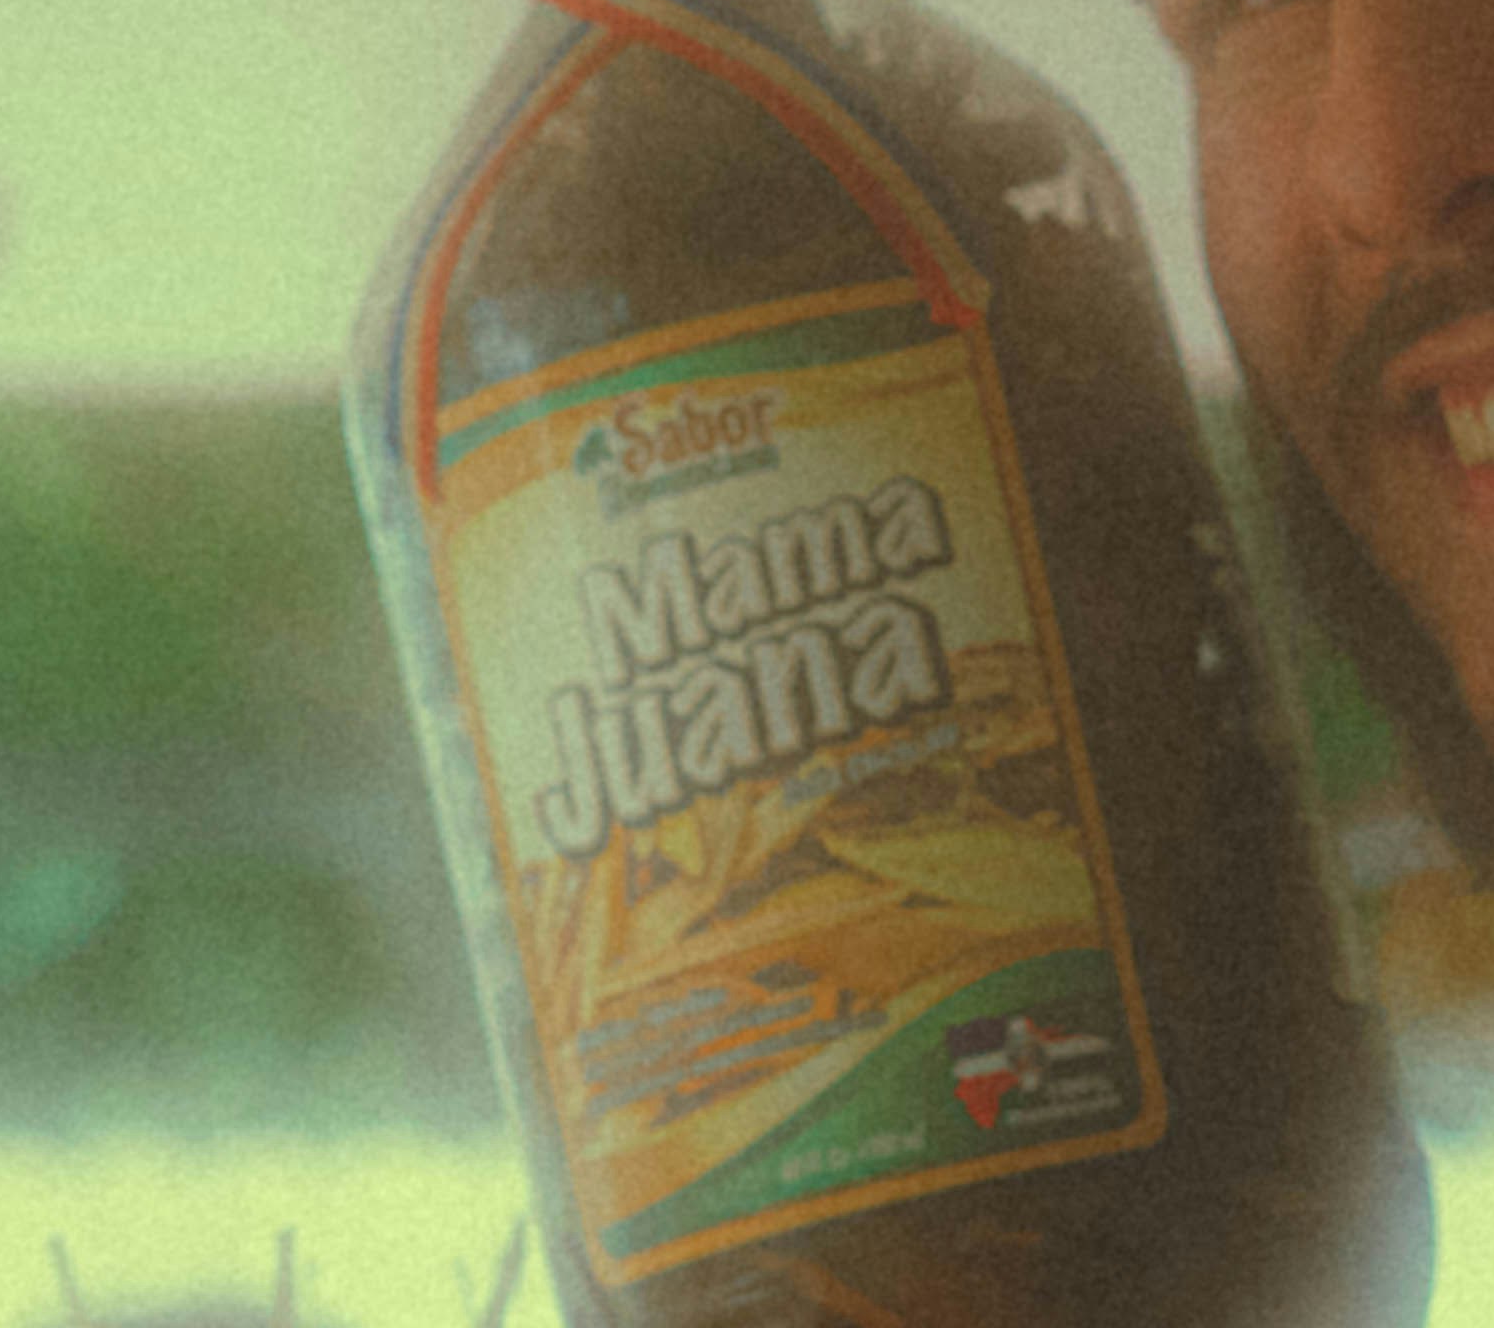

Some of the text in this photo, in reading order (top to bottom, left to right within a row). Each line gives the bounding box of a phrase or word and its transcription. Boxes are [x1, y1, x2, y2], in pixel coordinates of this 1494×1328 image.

[613, 390, 783, 478] Sabor
[583, 477, 952, 692] Mama
[535, 597, 952, 858] Juana
